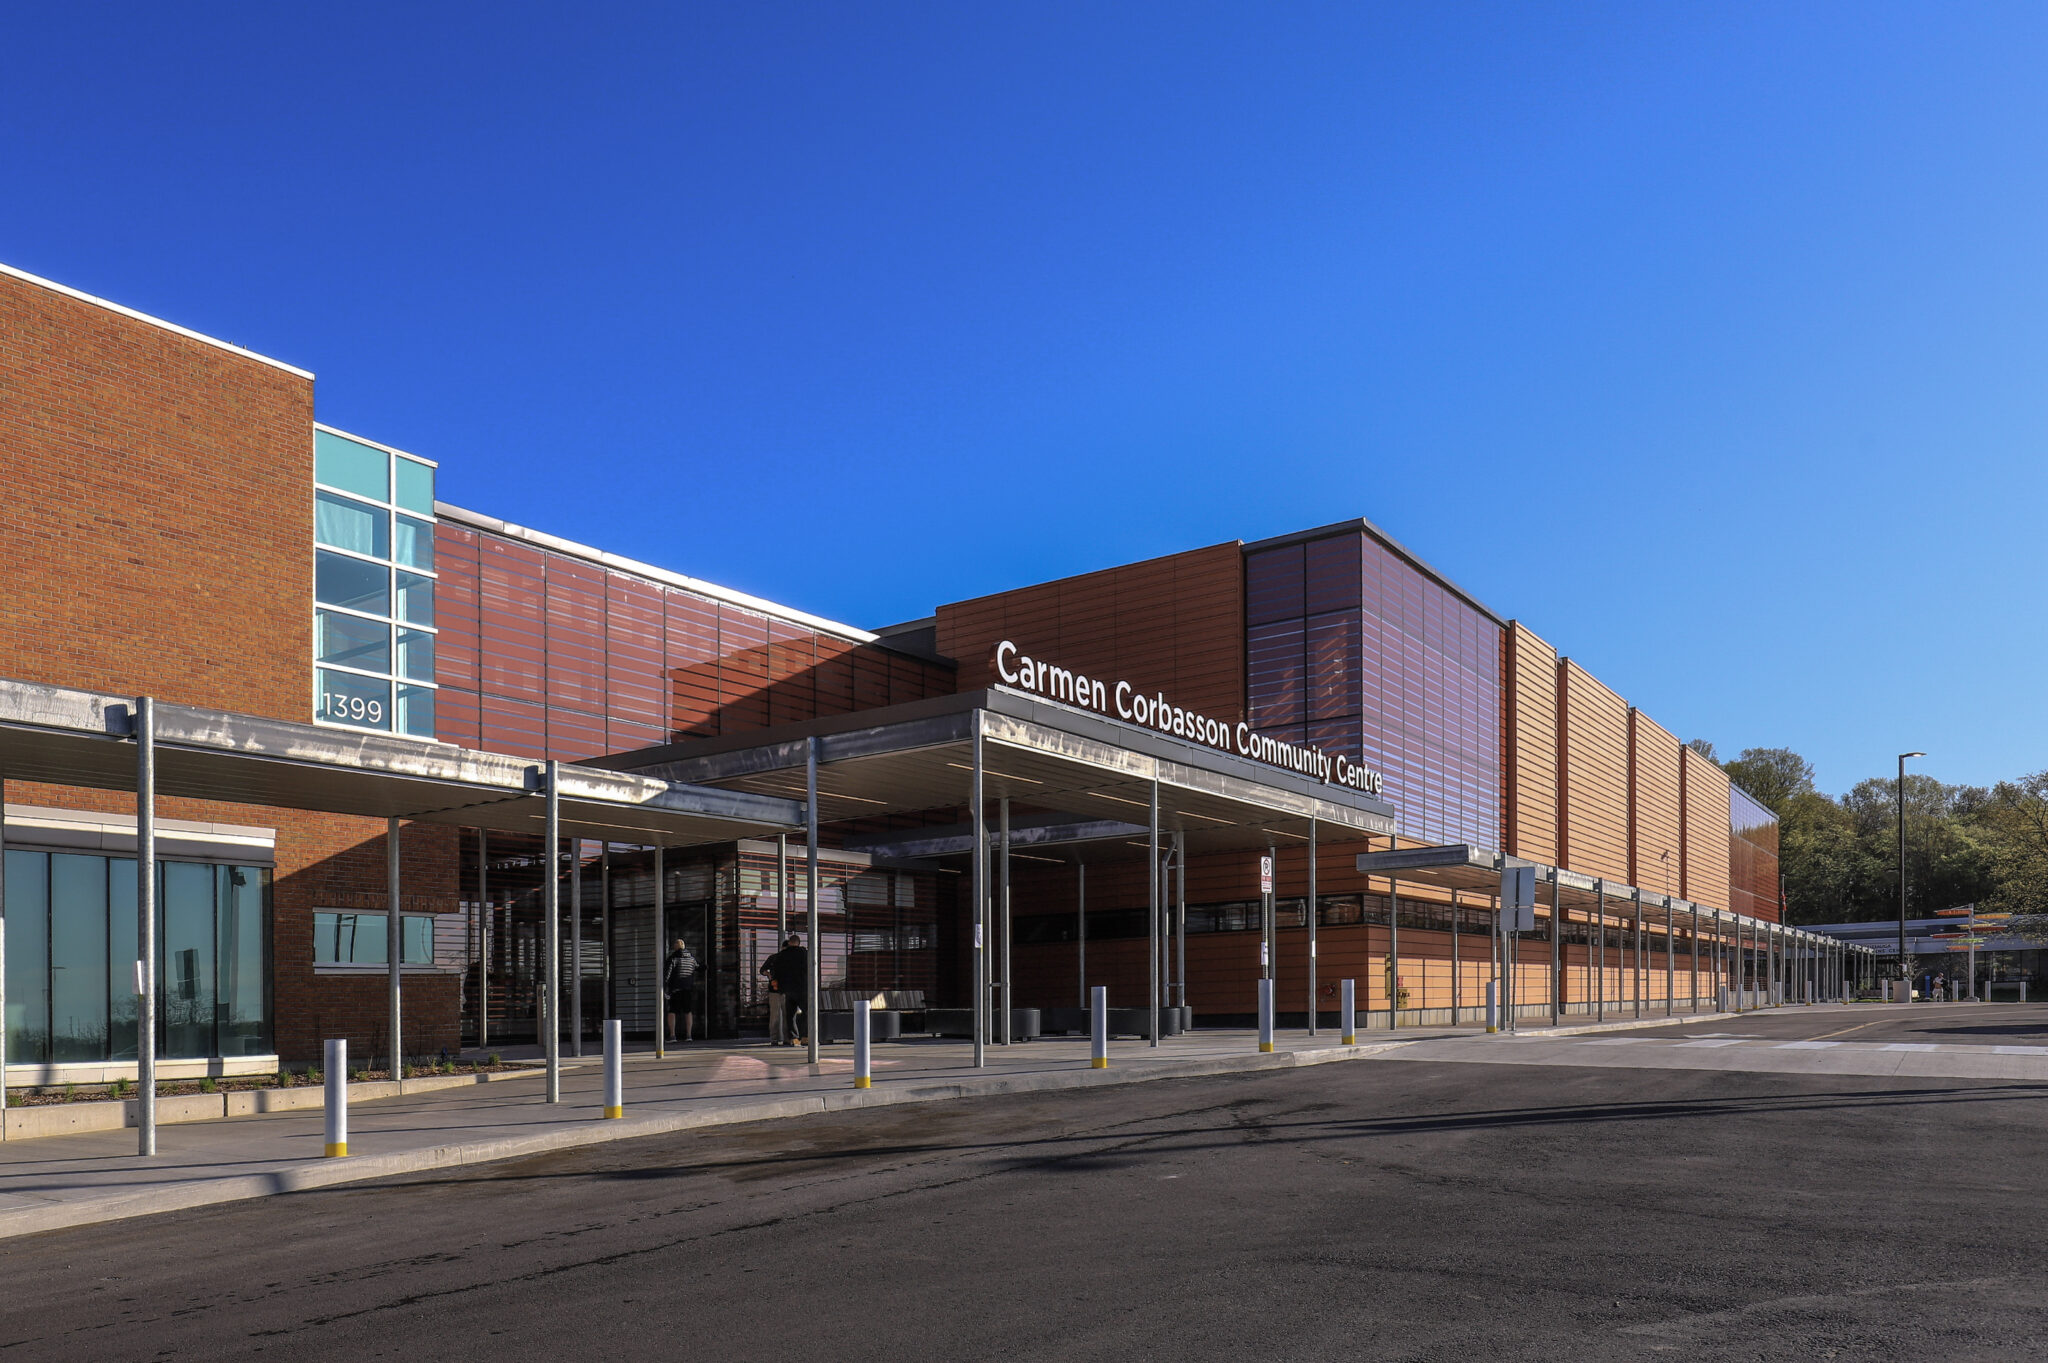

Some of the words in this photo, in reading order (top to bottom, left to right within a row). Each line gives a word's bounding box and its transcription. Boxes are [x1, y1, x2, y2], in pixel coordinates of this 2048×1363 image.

[323, 692, 382, 723] 1399
[997, 640, 1106, 712] Carmen
[1115, 680, 1230, 750] Corbasson
[1236, 721, 1332, 784] Community
[1336, 754, 1383, 794] Centre
